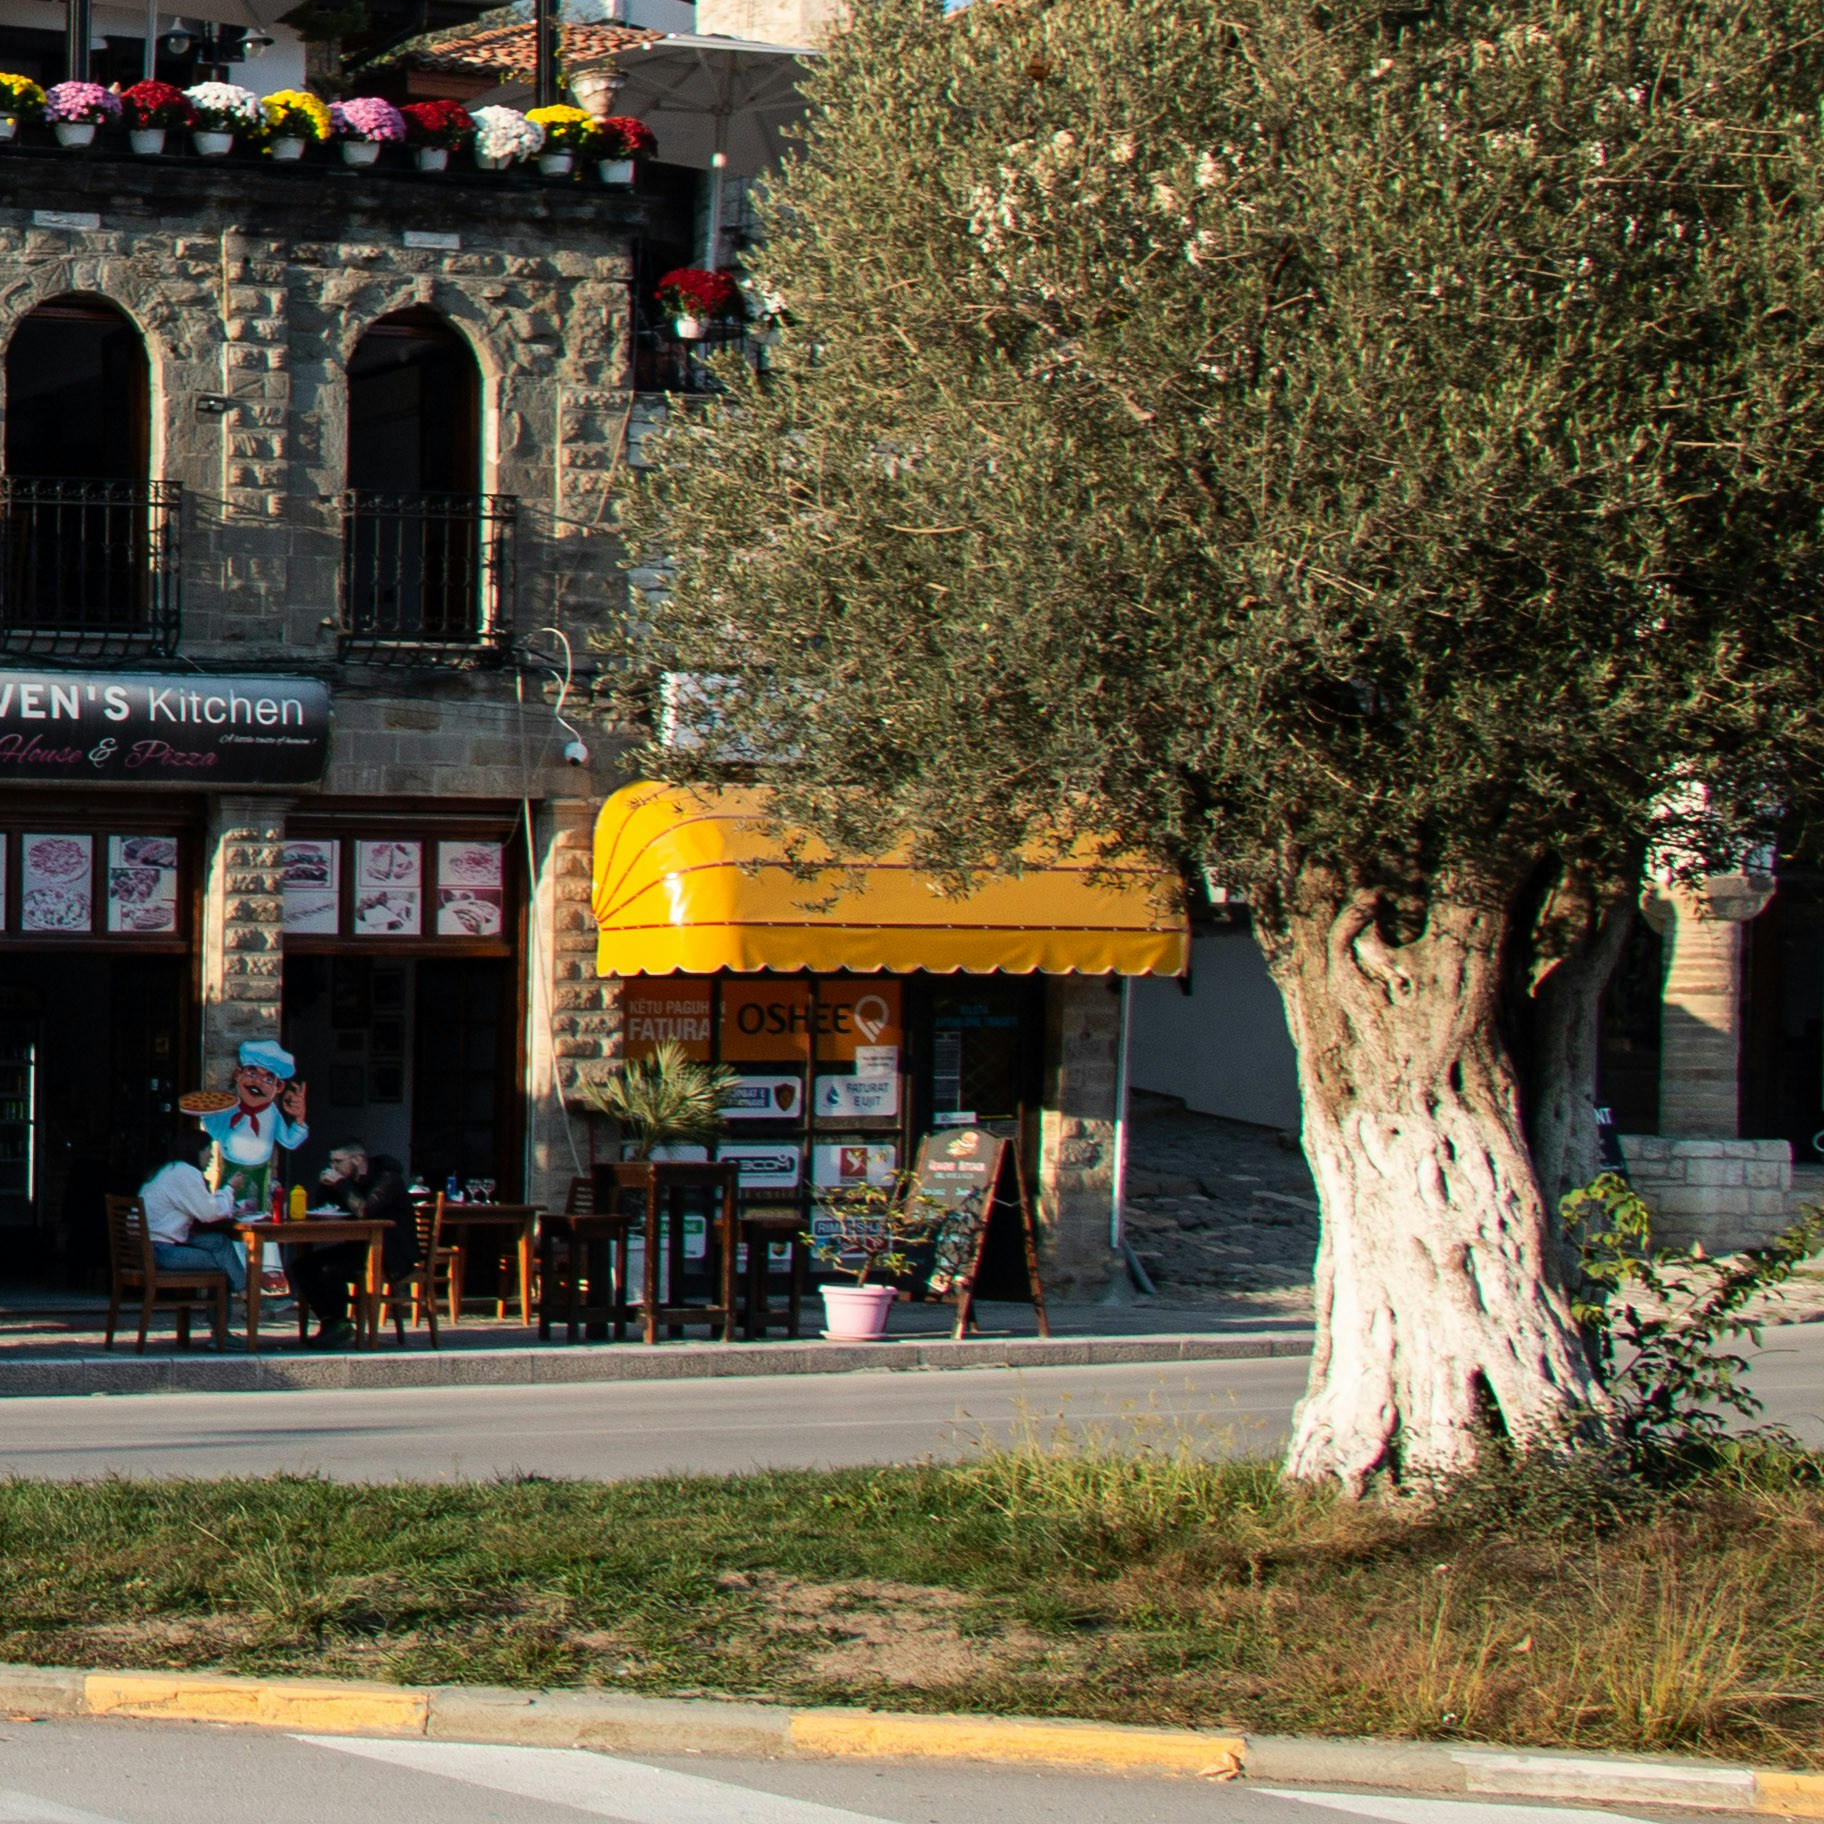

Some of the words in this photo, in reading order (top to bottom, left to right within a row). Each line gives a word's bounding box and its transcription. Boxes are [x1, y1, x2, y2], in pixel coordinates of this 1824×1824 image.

[149, 686, 303, 725] Kitchen
[88, 737, 118, 768] &
[125, 739, 218, 768] Pizza
[738, 1002, 852, 1034] OSHEE
